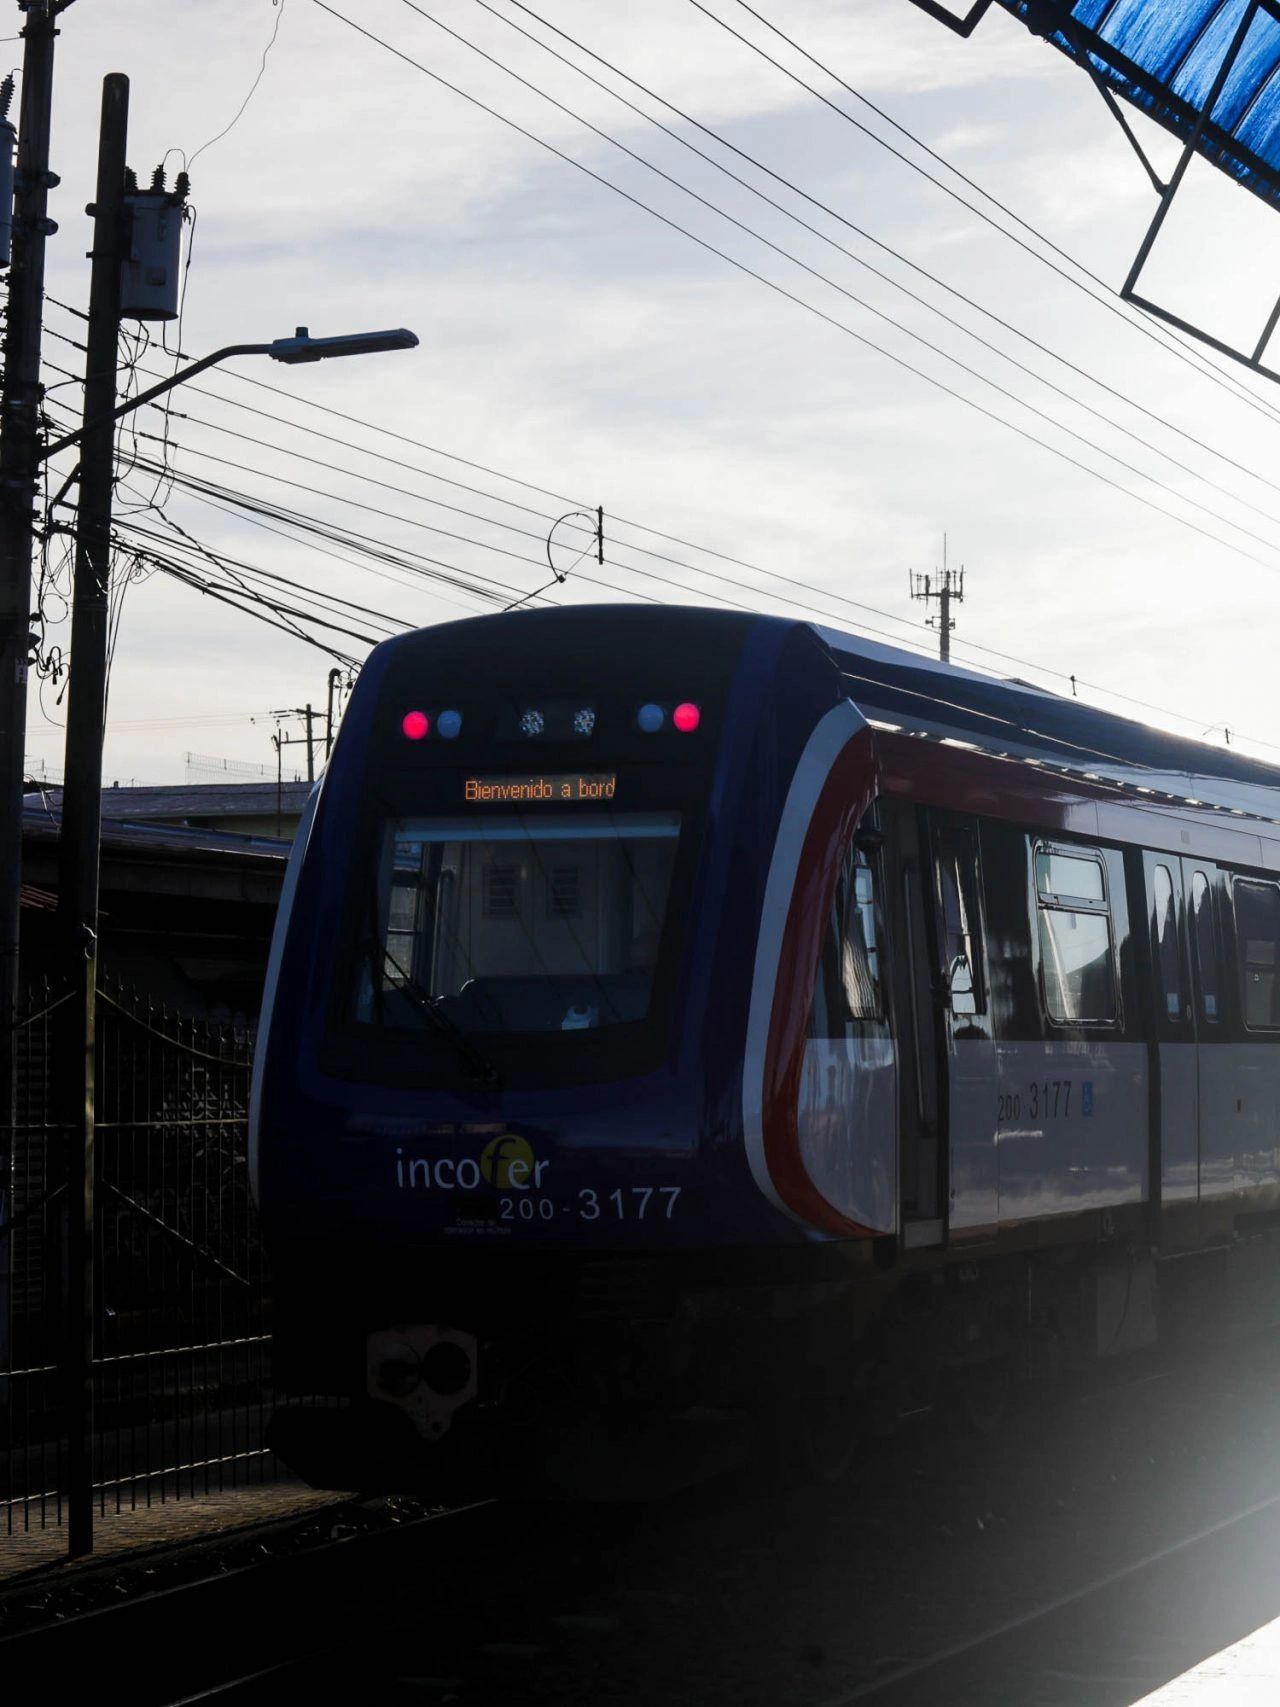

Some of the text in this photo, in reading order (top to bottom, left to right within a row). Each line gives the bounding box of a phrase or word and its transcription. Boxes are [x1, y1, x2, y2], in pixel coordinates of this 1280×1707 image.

[465, 778, 616, 800] Bienvenido a bord
[396, 1137, 550, 1189] incofer
